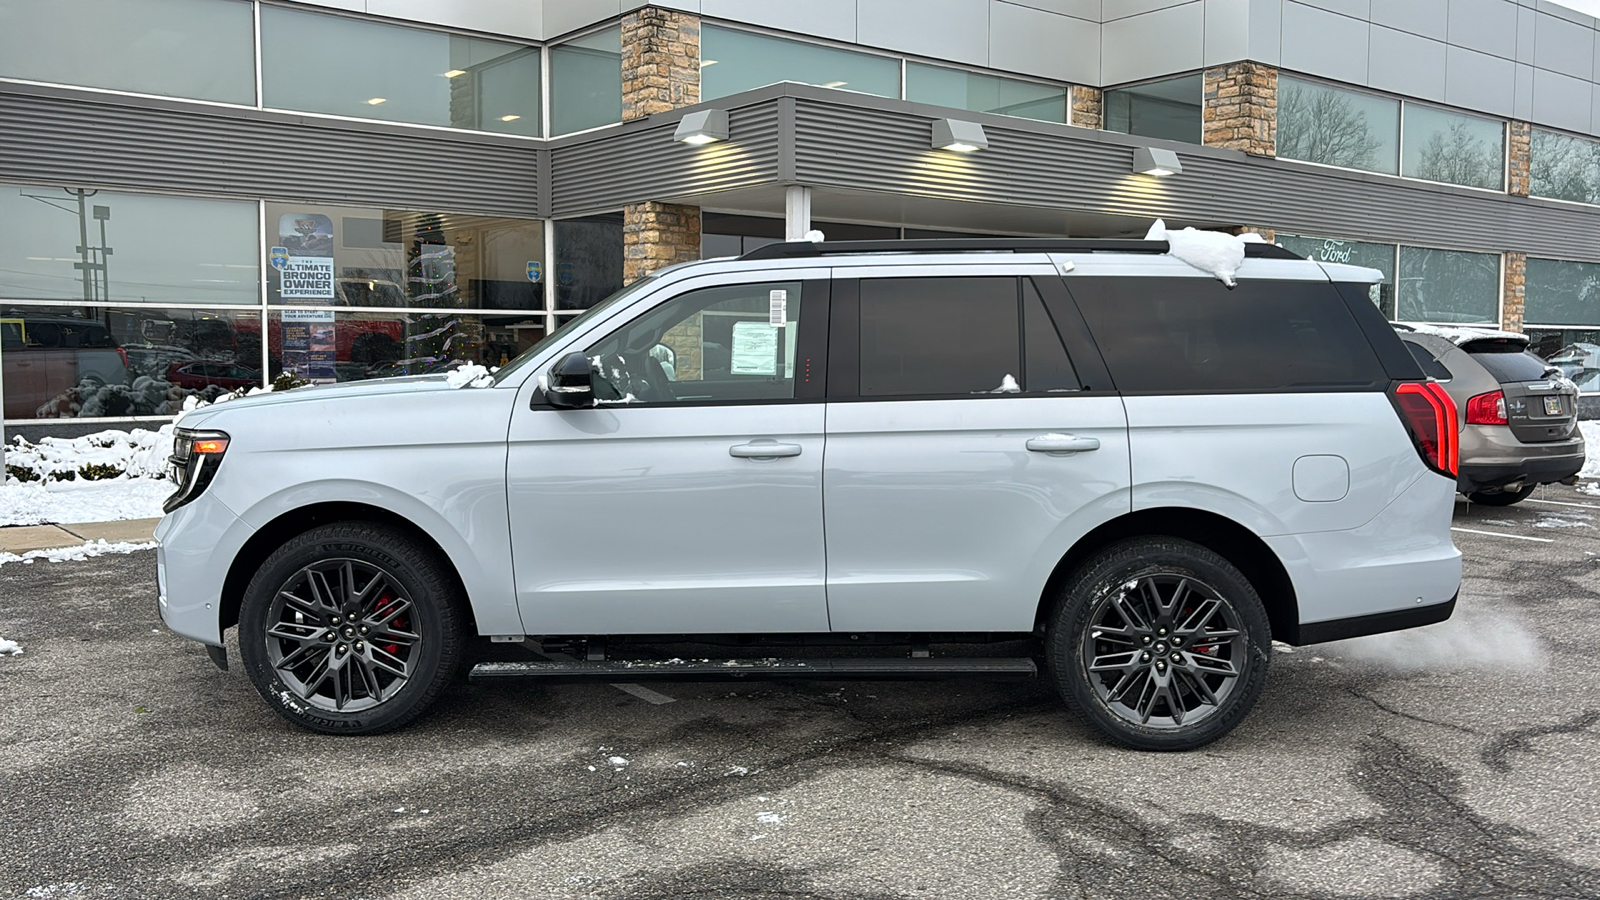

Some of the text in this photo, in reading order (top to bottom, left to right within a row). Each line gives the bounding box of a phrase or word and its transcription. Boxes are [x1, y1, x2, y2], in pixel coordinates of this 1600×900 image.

[1321, 239, 1351, 263] Ford
[283, 272, 331, 280] BRONCO
[284, 280, 331, 289] OWNER
[341, 544, 398, 567] MICHELIN
